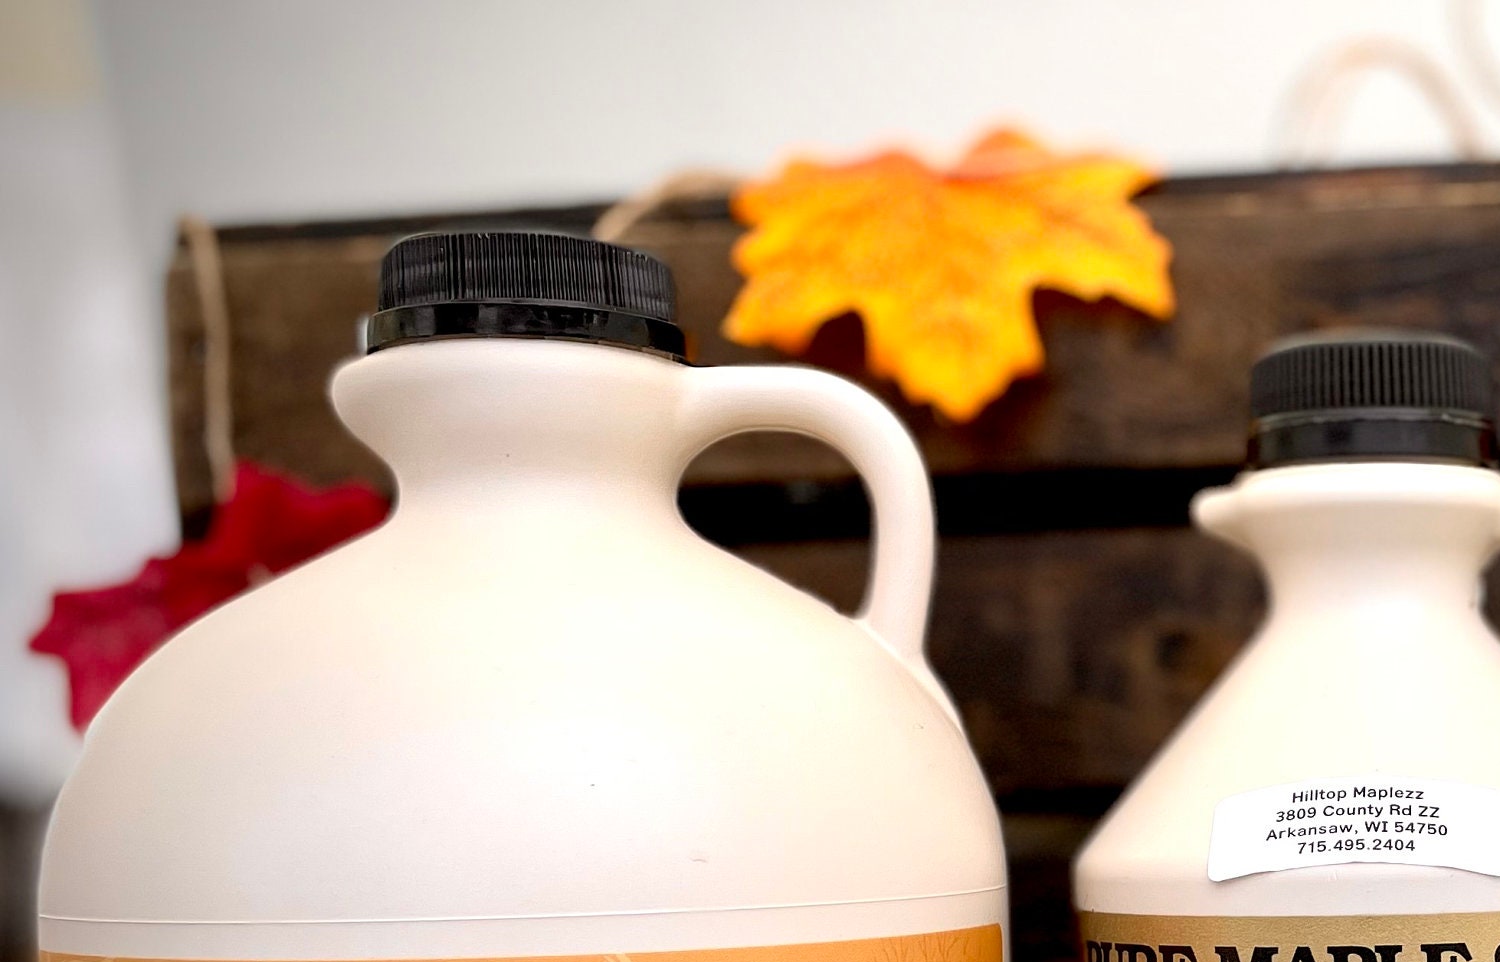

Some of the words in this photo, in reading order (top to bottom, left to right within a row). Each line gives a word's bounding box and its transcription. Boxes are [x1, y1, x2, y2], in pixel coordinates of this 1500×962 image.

[1292, 788, 1347, 803] Hilltop
[1353, 787, 1424, 800] Maplezz
[1276, 808, 1317, 822] 3809
[1323, 804, 1383, 818] County
[1389, 804, 1411, 816] Rd
[1418, 806, 1439, 818] ZZ
[1266, 823, 1358, 841] Arkansaw,
[1365, 821, 1388, 833] WI
[1395, 822, 1447, 836] 54750
[1298, 839, 1415, 854] 715.495.2404
